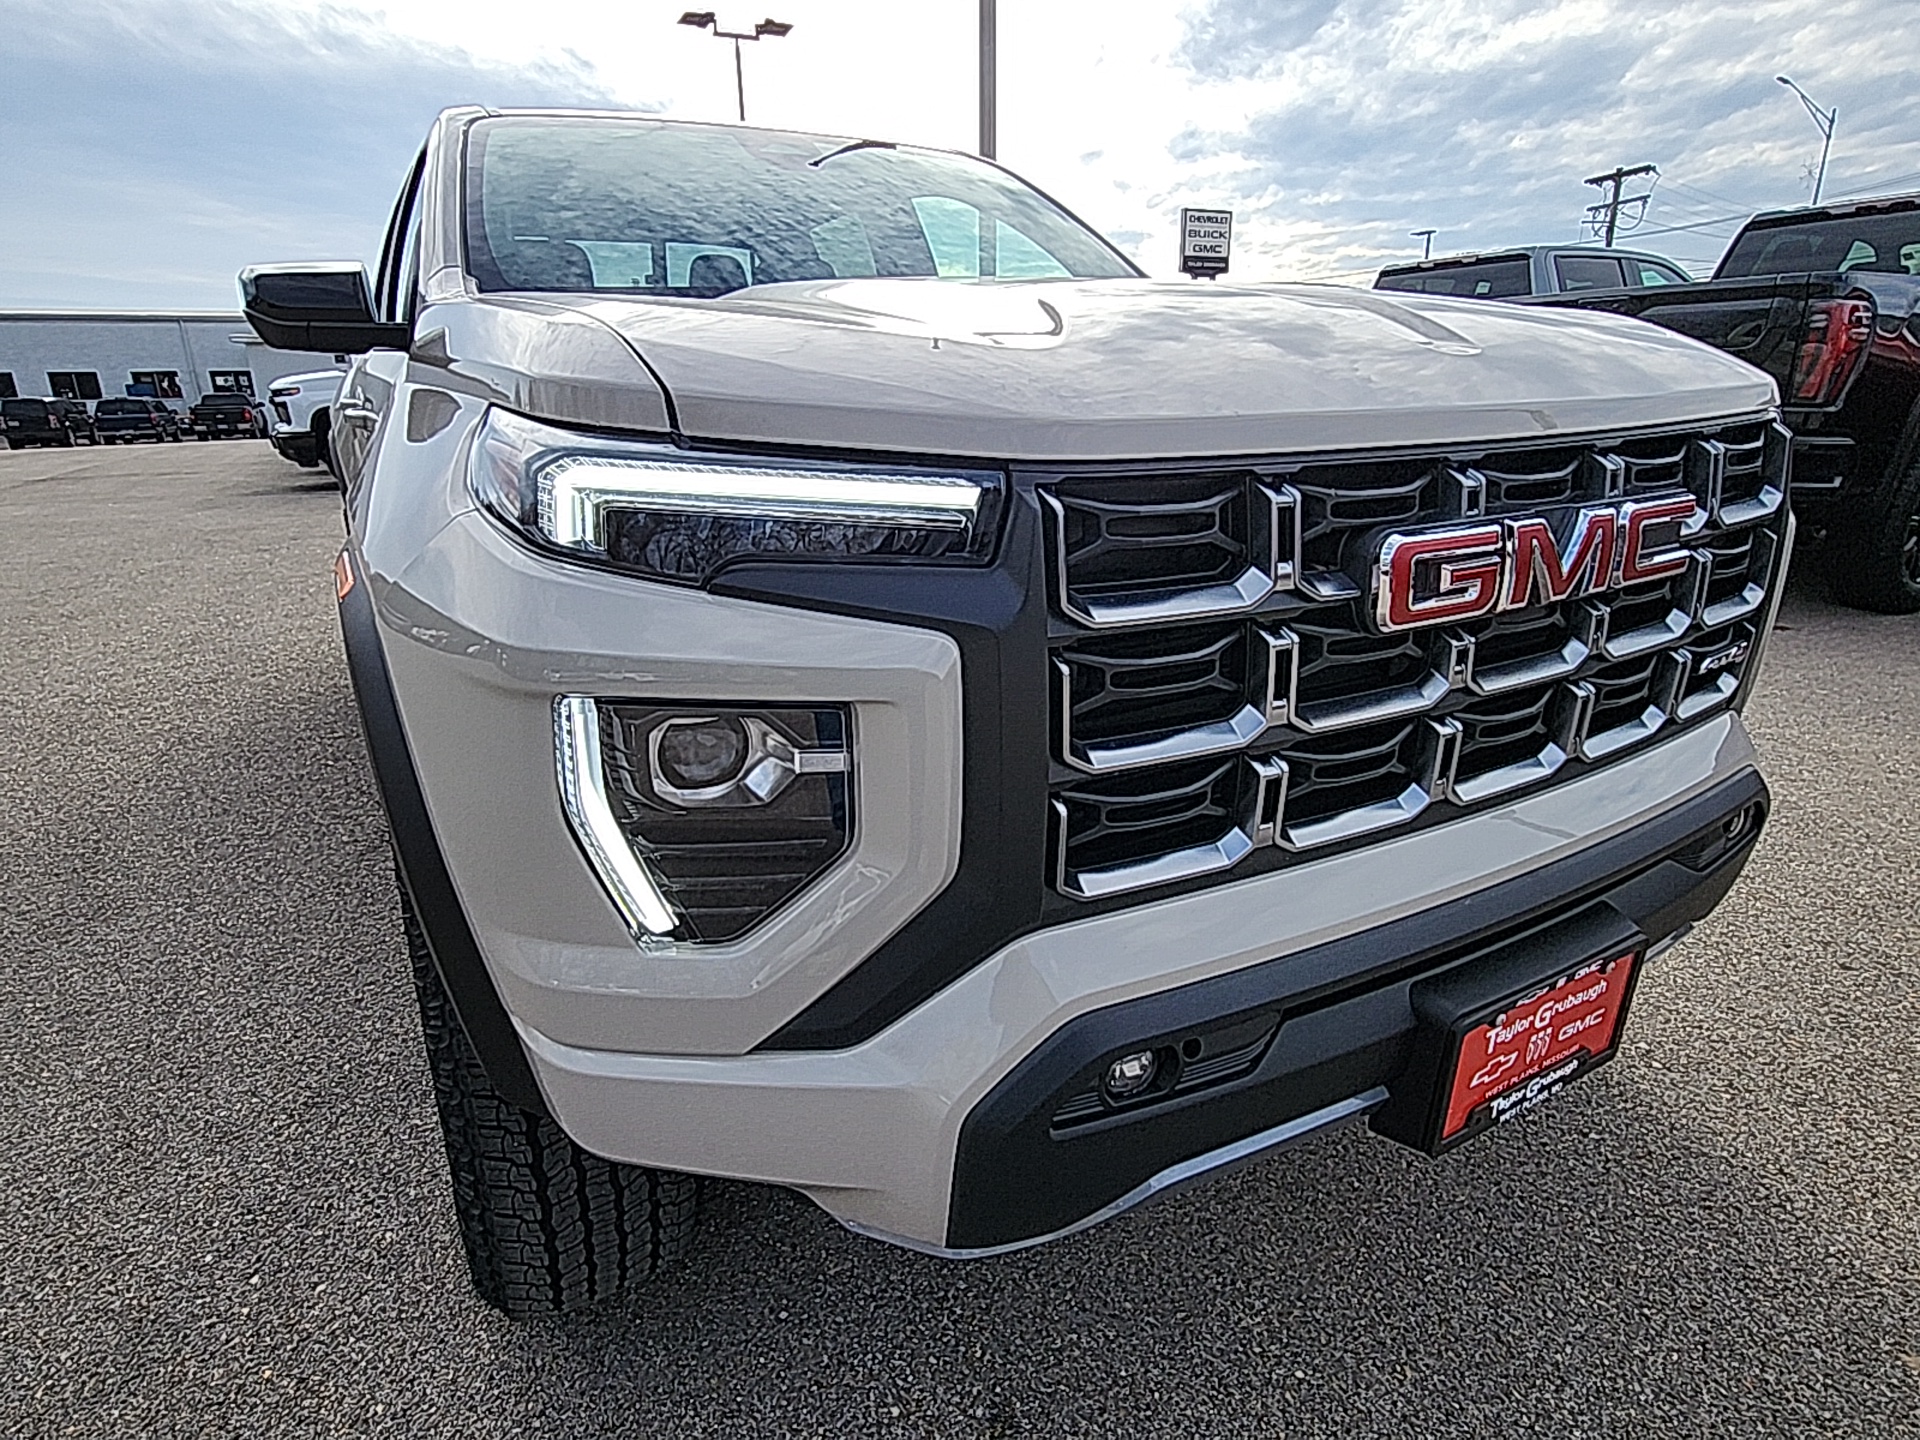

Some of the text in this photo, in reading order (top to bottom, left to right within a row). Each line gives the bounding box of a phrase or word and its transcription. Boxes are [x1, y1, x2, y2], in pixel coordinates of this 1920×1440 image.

[1187, 228, 1228, 240] BUICK
[1188, 214, 1229, 225] CHEVROLET
[1192, 243, 1223, 254] GMC
[1378, 493, 1698, 633] GMC
[1485, 978, 1608, 1055] Taylor Grubaugh
[1558, 1007, 1606, 1041] GMC
[1489, 1058, 1579, 1119] Taylor Grubaugh
